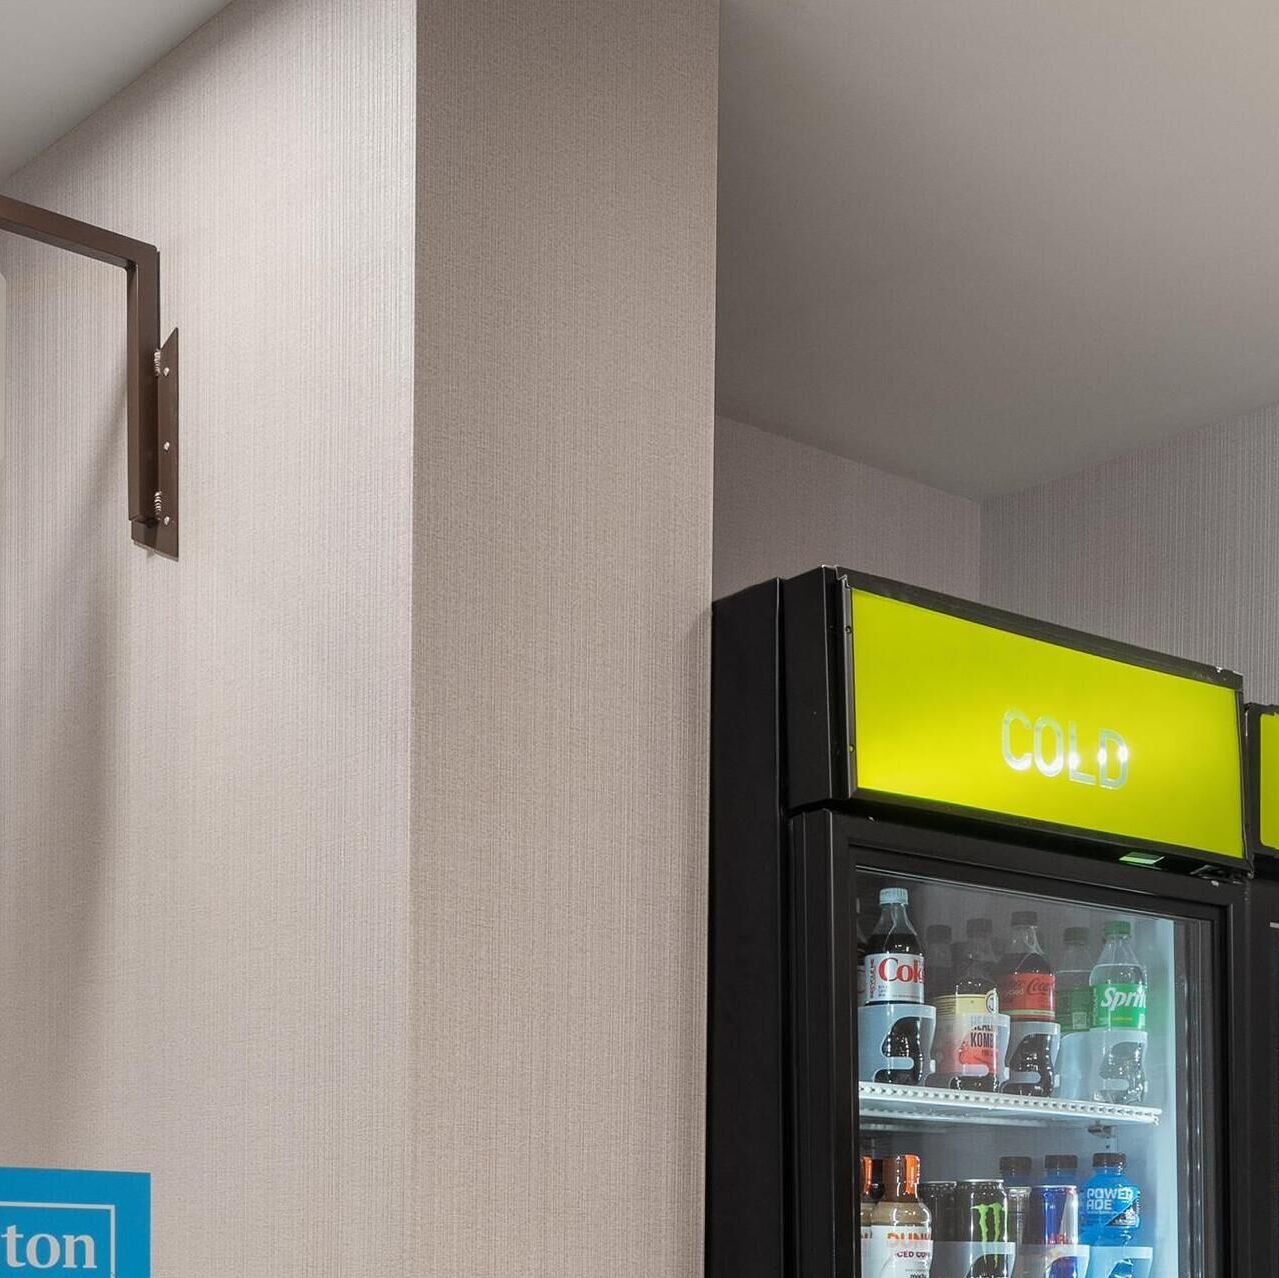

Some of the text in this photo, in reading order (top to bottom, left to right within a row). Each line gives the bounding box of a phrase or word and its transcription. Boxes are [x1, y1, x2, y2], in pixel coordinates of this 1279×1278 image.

[1001, 707, 1129, 790] COLD
[1087, 1188, 1134, 1200] POWER
[1087, 1200, 1112, 1210] ADE
